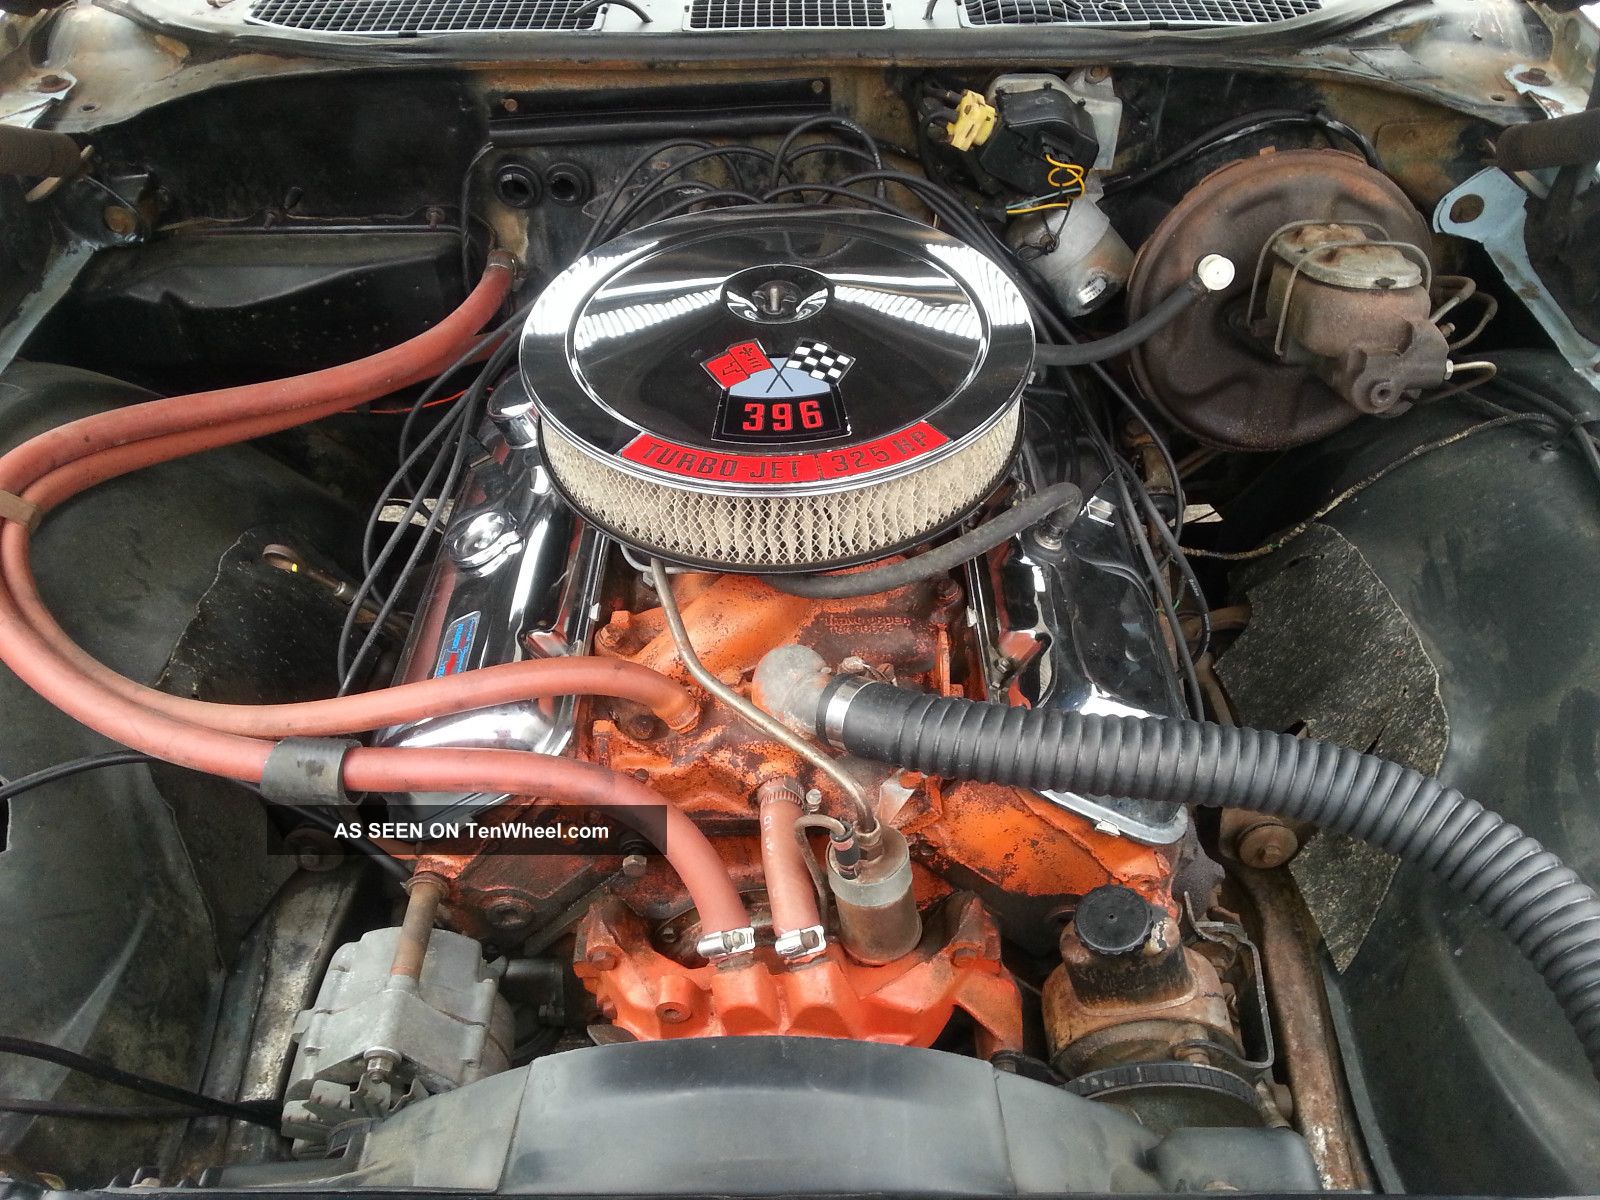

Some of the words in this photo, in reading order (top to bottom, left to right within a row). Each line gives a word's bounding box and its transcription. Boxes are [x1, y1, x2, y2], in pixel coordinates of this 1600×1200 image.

[742, 400, 823, 431] 396
[831, 444, 890, 471] 325
[897, 430, 930, 457] HP
